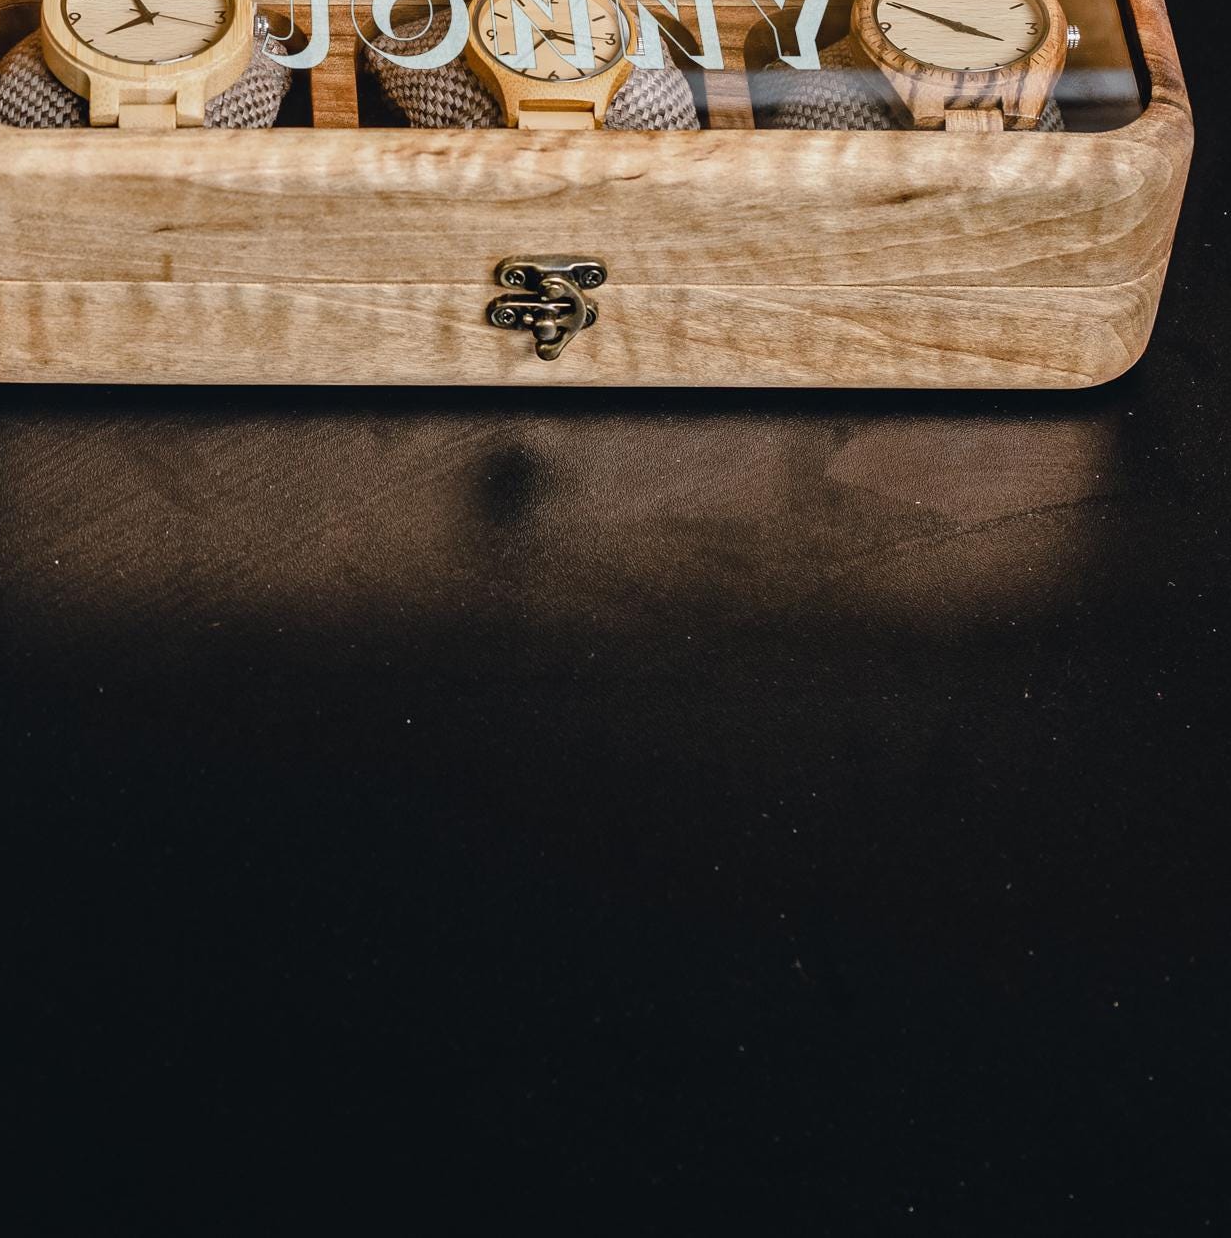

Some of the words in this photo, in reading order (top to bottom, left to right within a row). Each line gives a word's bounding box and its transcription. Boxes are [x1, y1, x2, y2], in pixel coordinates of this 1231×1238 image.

[68, 11, 82, 26] 9
[214, 10, 227, 25] 3
[879, 21, 892, 34] 9
[1024, 21, 1039, 36] 3
[485, 28, 498, 42] 9
[604, 32, 617, 46] 3
